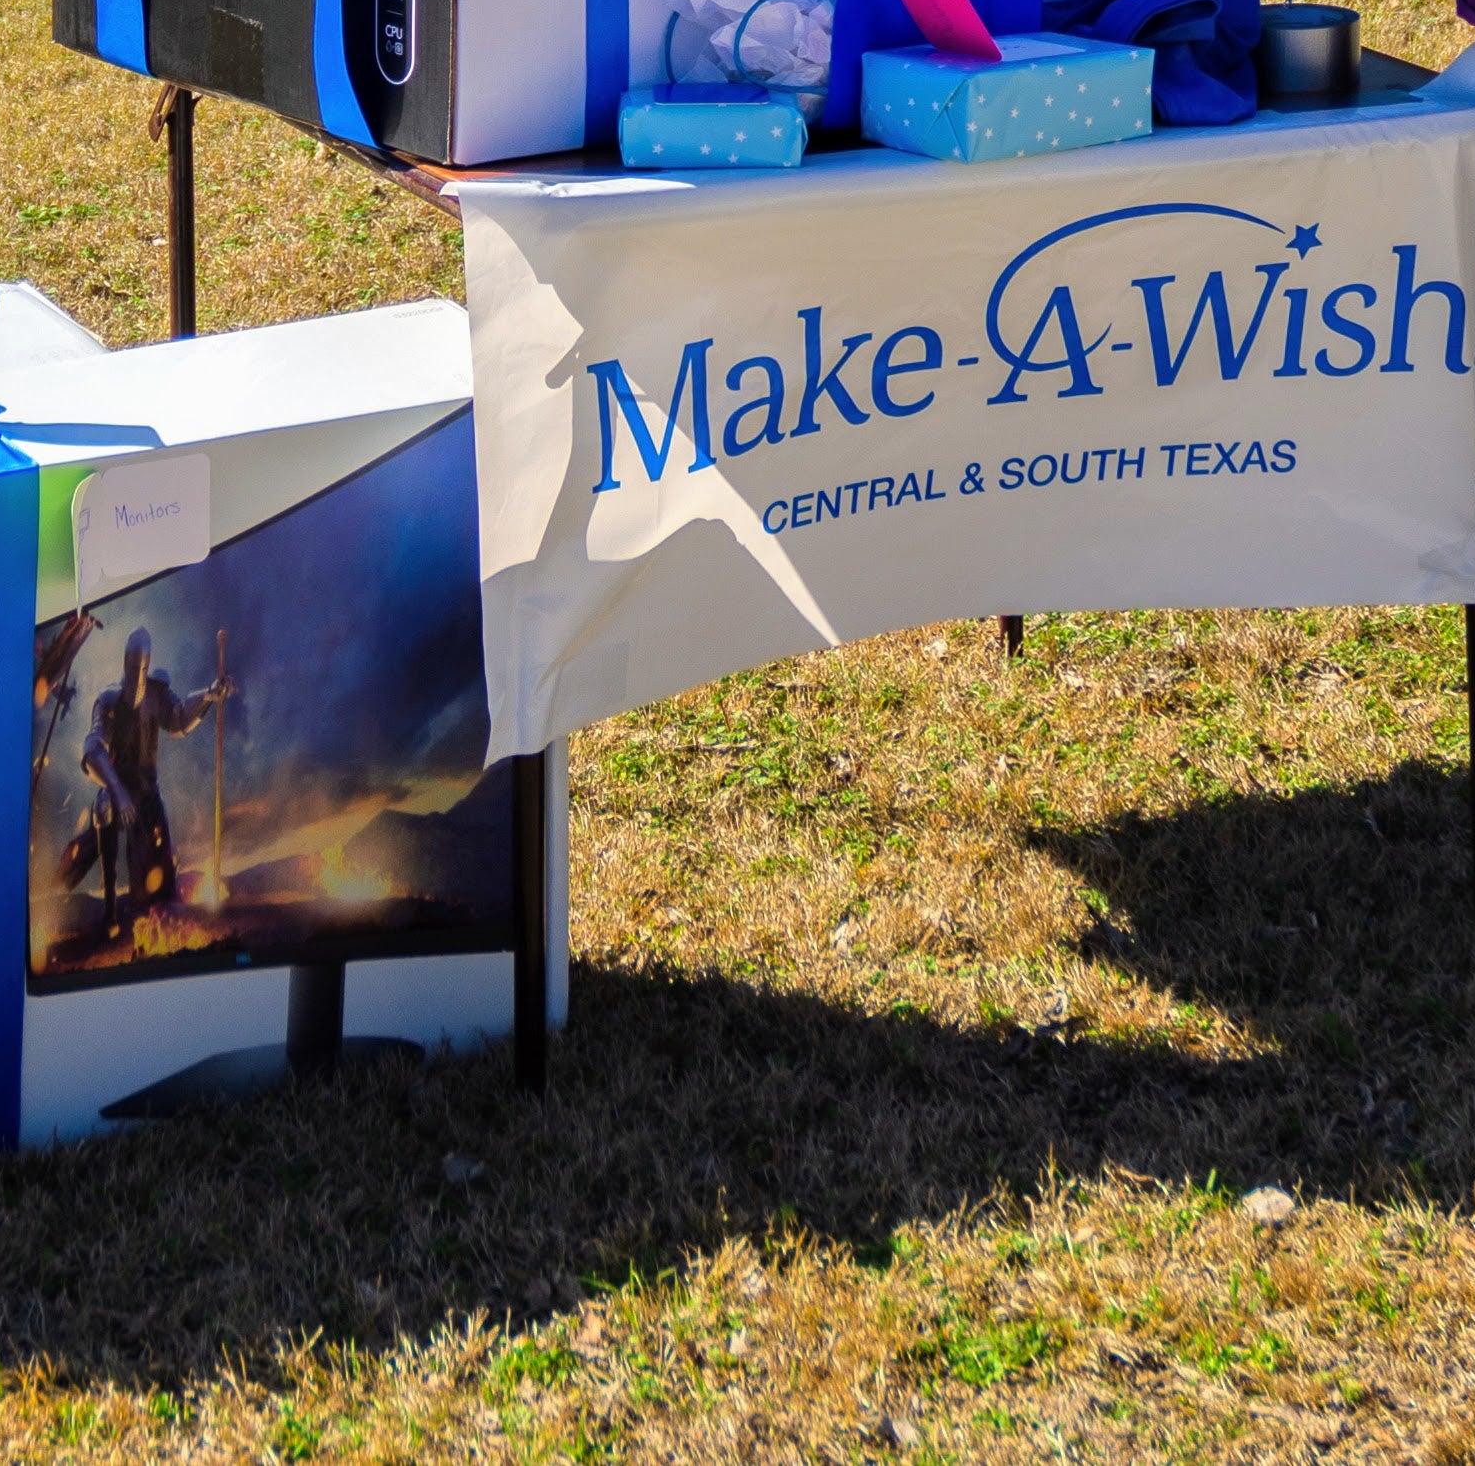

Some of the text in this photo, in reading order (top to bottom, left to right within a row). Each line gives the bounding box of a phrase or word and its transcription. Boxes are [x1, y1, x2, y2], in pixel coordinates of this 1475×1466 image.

[385, 24, 403, 40] CPU
[762, 438, 1298, 536] CENTRAL & SOUTH TEXAS
[114, 501, 181, 530] Monitors
